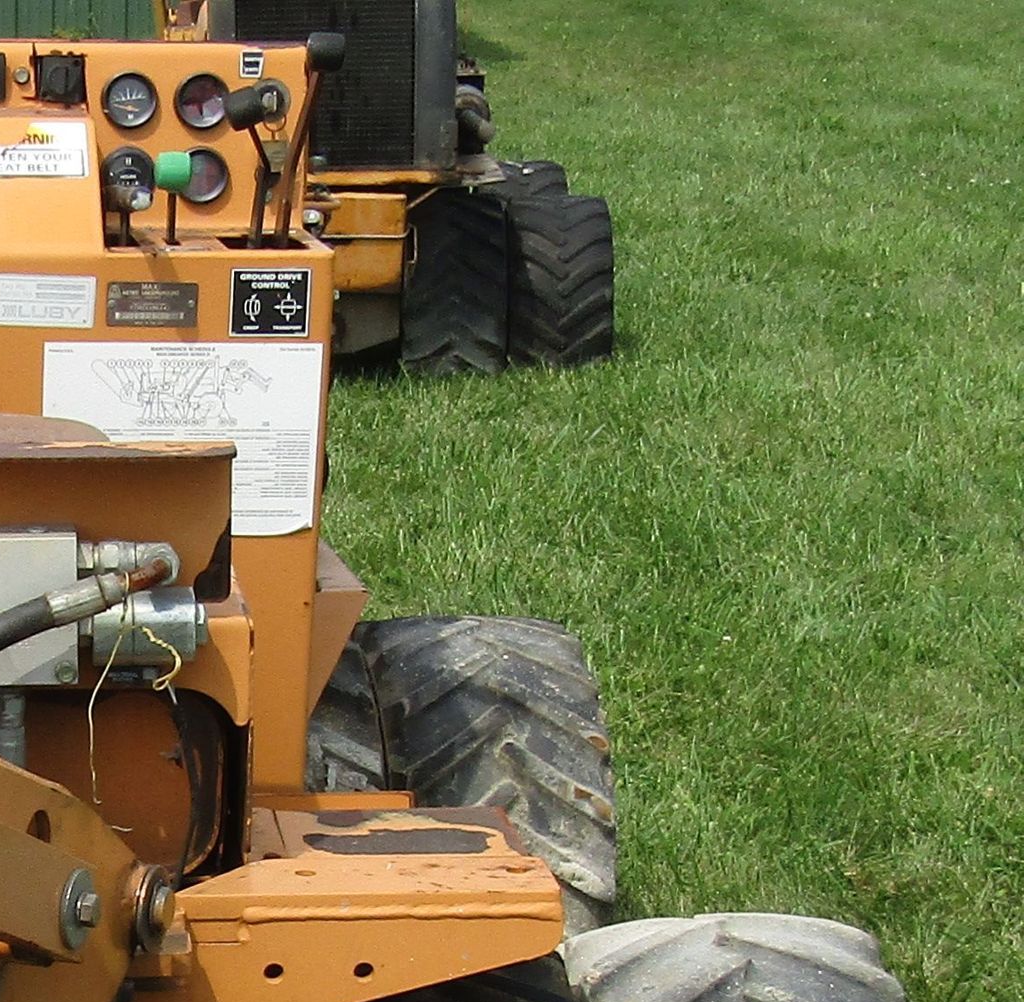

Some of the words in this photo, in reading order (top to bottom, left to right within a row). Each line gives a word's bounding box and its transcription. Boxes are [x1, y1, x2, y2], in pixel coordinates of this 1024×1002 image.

[32, 153, 72, 162] YOUR
[27, 163, 59, 172] BELT
[239, 273, 276, 281] GROUND
[277, 273, 303, 281] DRIVE
[251, 281, 290, 289] CONTROL
[17, 304, 82, 319] LUBY
